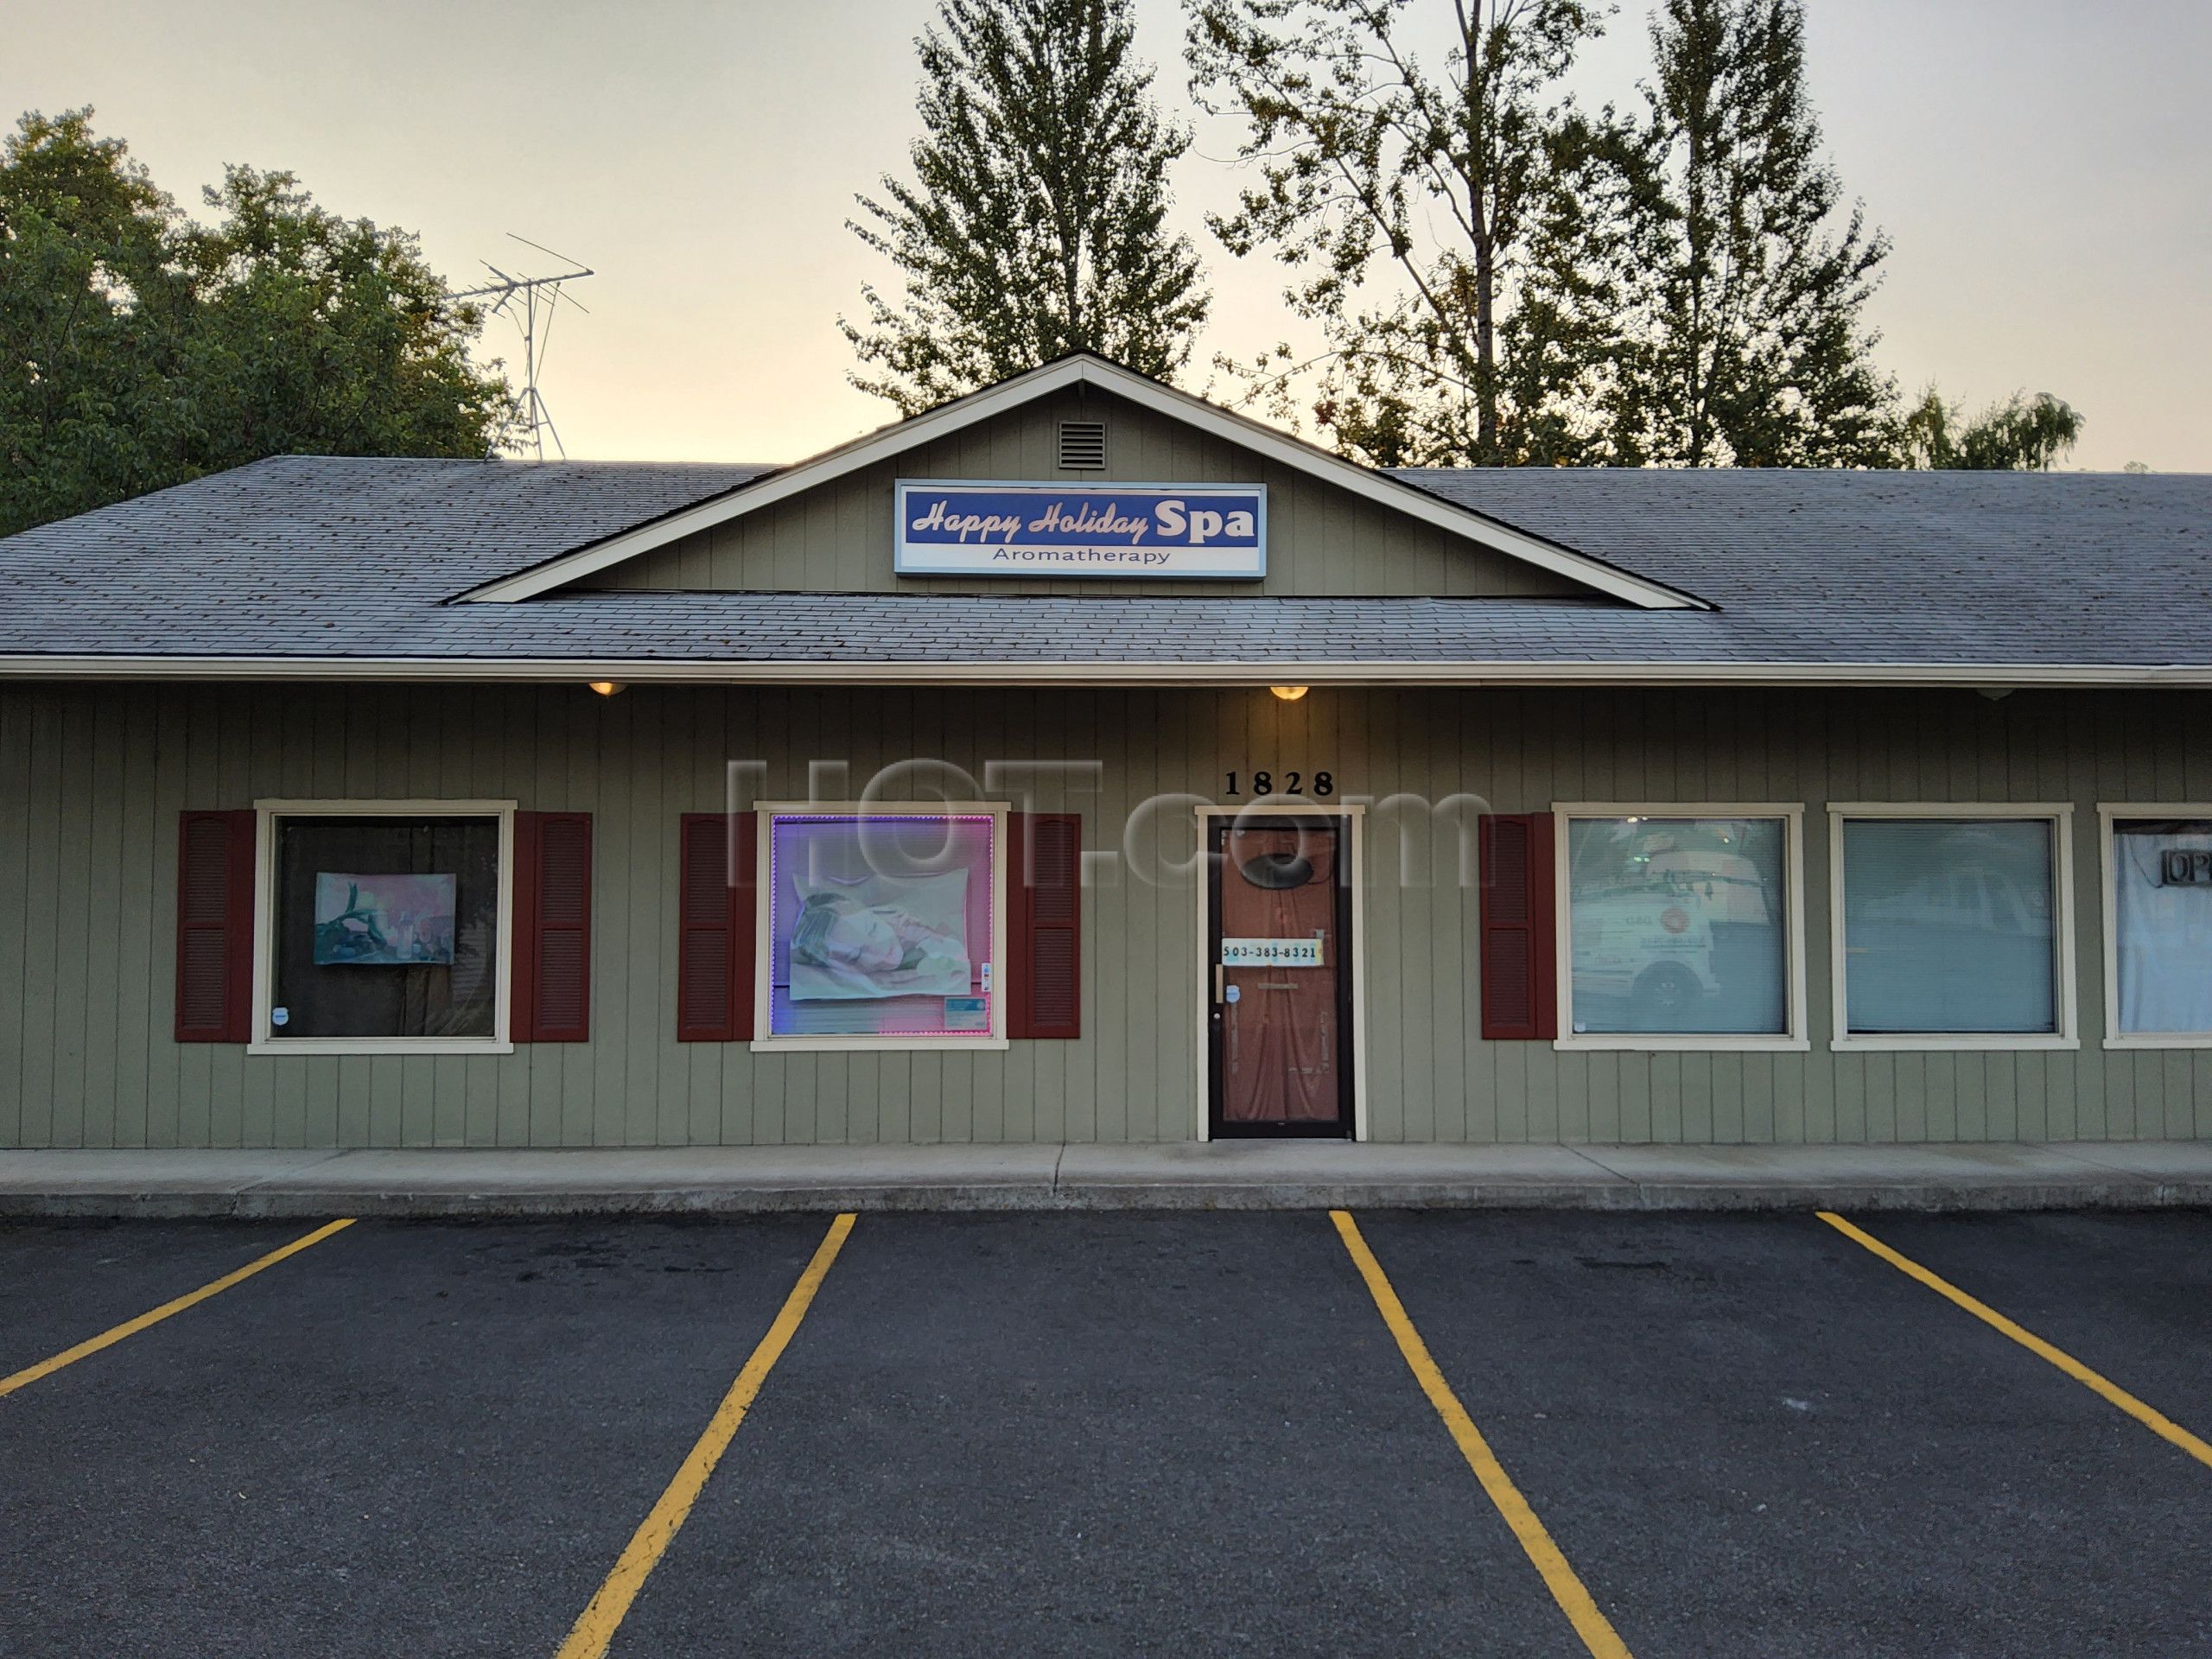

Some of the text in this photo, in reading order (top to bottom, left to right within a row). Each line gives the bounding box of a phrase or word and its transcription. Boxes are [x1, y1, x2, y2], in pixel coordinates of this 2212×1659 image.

[912, 500, 1255, 545] Happy Holiday Spa
[993, 548, 1171, 564] Aromatherapy
[1225, 771, 1333, 796] 1828
[1224, 946, 1315, 958] 503-383-8321
